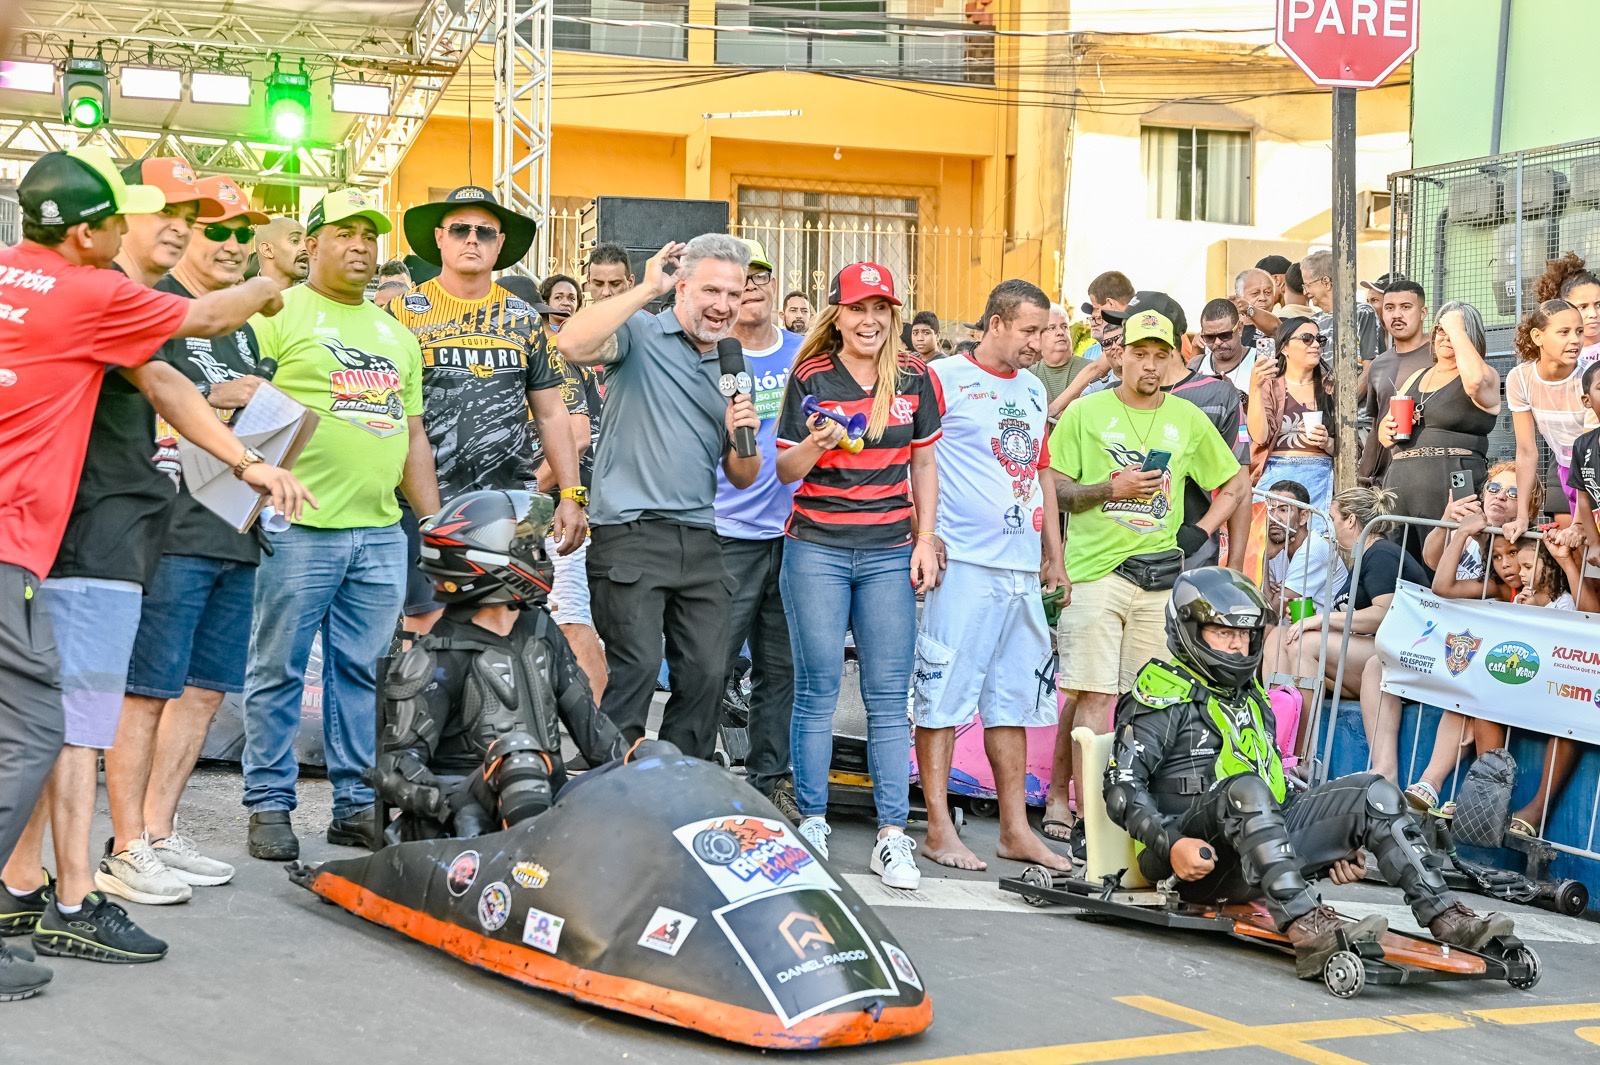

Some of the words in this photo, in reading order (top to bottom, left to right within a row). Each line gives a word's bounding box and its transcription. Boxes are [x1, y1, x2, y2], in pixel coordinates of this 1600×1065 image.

[1287, 0, 1408, 37] PARE
[462, 337, 495, 347] EQUIPE
[439, 348, 519, 367] CAMARO
[720, 377, 735, 390] sbt
[330, 399, 389, 415] RACING
[998, 407, 1027, 416] COROA
[1102, 500, 1153, 513] RACING
[490, 565, 543, 599] TORK
[1419, 599, 1442, 609] Apoio:
[1400, 656, 1409, 664] AO
[1409, 658, 1435, 669] ESPORTE
[1413, 653, 1437, 663] INCENTIVO
[1488, 662, 1507, 674] CASA
[1515, 666, 1536, 679] VERDE
[1553, 662, 1580, 672] EXCELÊNCIA
[729, 839, 785, 880] Risca
[776, 959, 825, 984] DANIEL
[822, 949, 869, 966] PARODI
